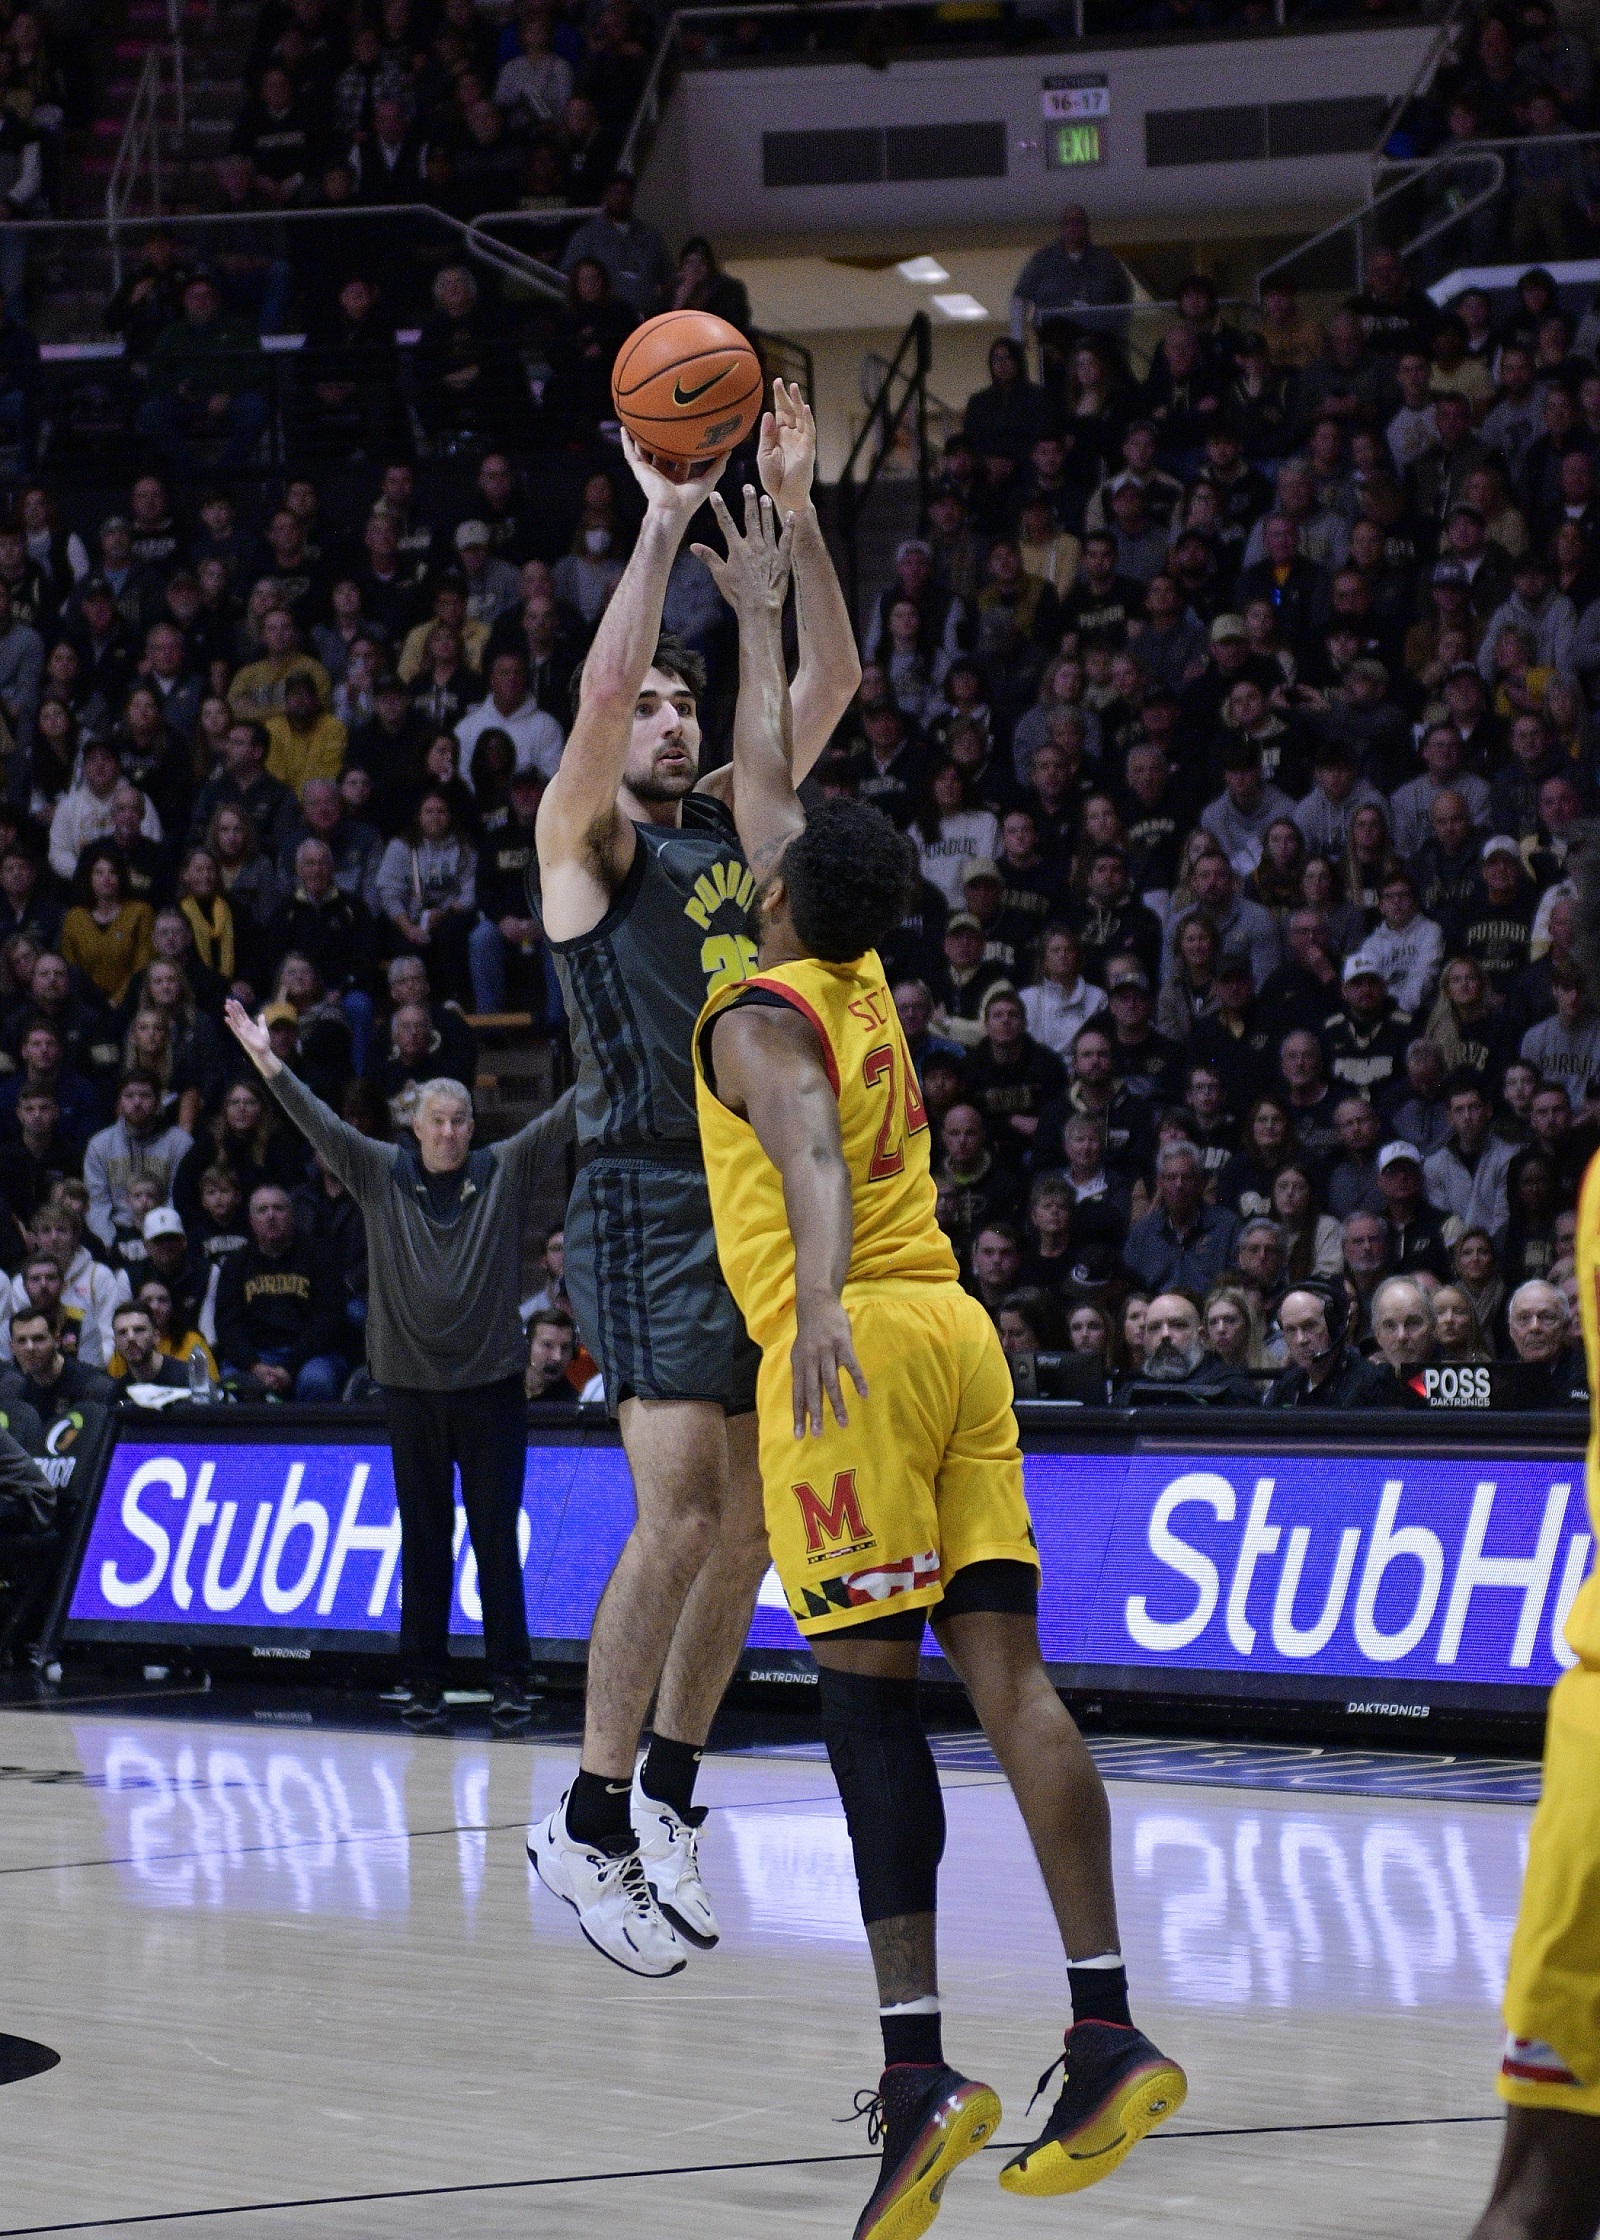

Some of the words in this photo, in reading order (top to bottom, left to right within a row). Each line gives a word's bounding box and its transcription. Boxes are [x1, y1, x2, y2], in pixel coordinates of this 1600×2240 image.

[1050, 91, 1102, 111] 16-17
[1058, 126, 1099, 164] EXIT
[863, 1033, 929, 1183] 24
[244, 1272, 312, 1304] PURDUE
[1425, 1367, 1491, 1399] POSS
[1430, 1397, 1491, 1408] DAKTRONICS
[791, 1469, 873, 1554] M
[252, 1647, 312, 1659] DAKTRONICS
[750, 1670, 819, 1685] DAKTRONICS
[1347, 1702, 1430, 1718] DAKTRONICS
